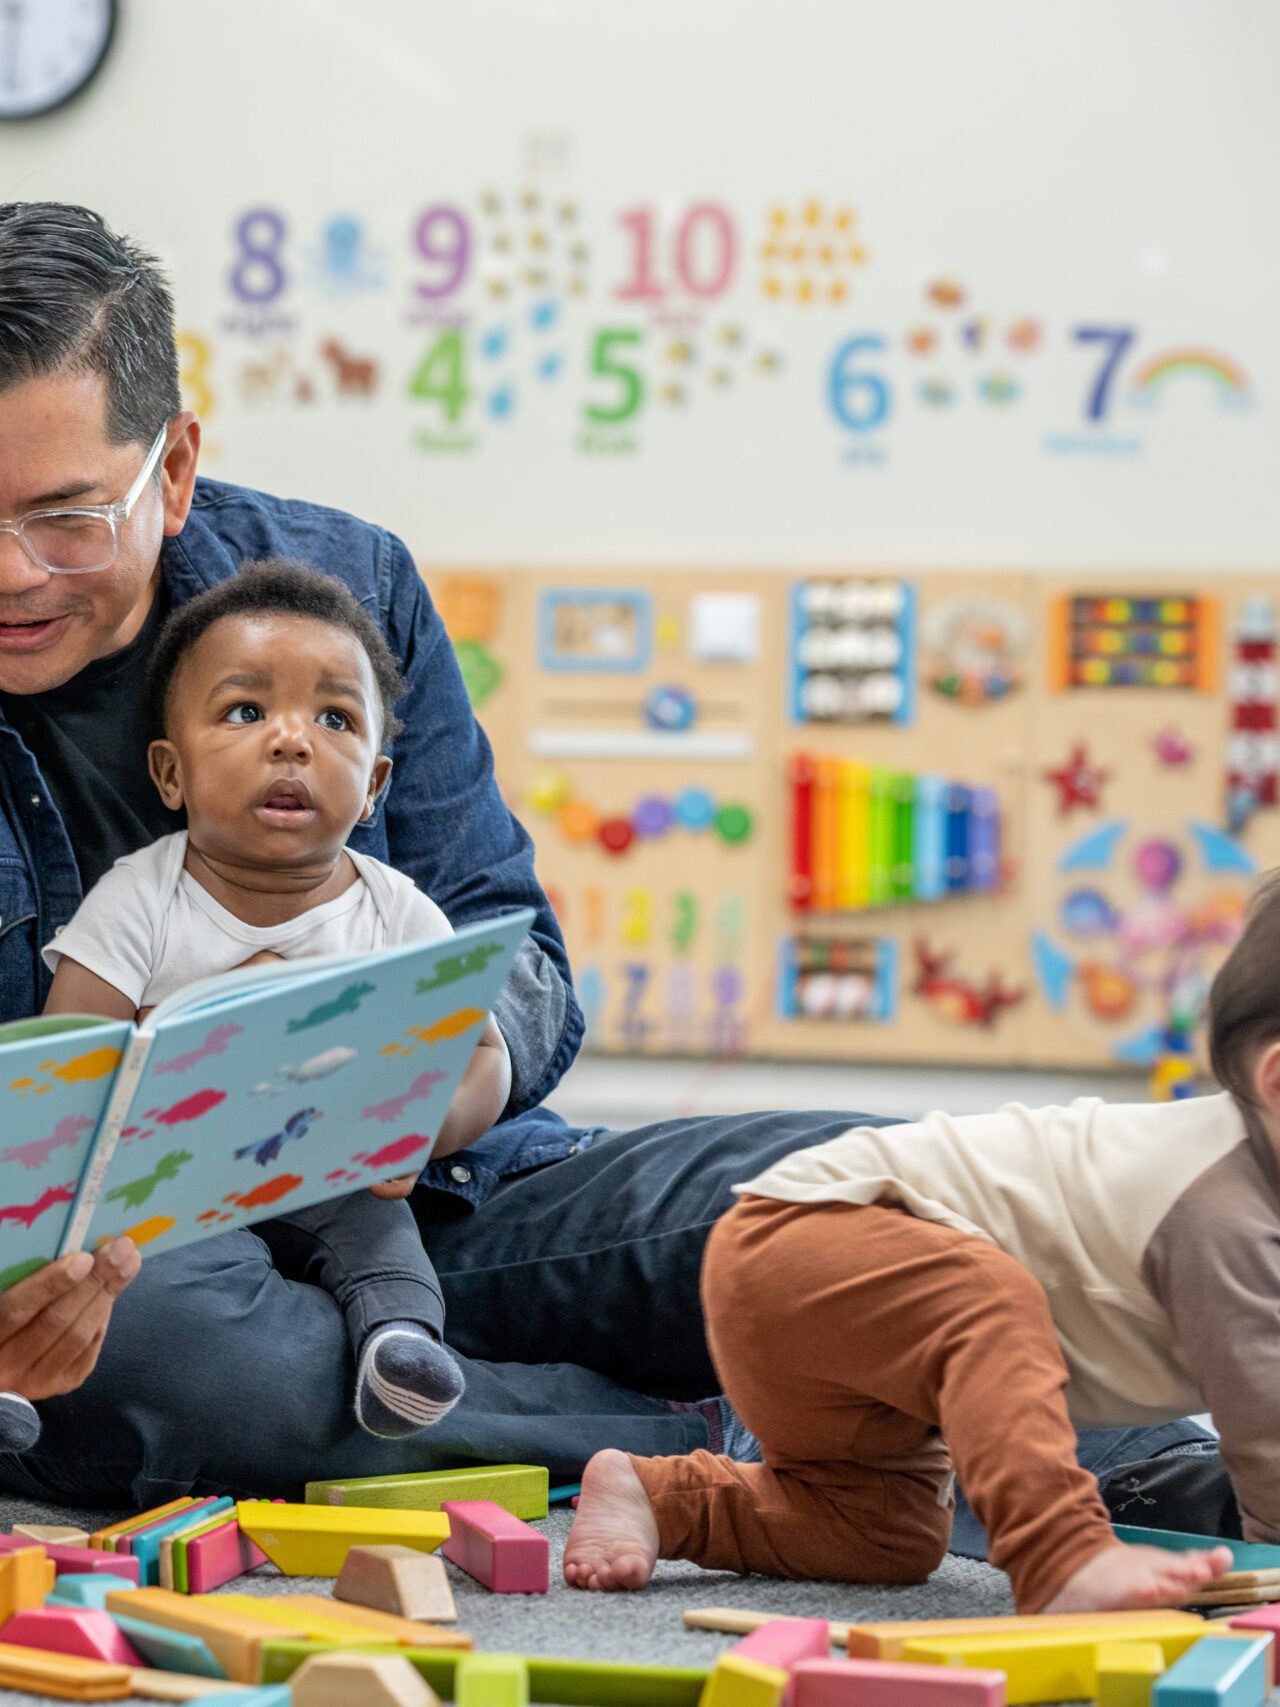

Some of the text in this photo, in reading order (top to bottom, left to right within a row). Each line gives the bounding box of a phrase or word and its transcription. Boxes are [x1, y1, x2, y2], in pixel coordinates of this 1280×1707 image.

[227, 207, 288, 304] 8
[411, 203, 472, 303] 9
[612, 201, 738, 305] 10
[408, 322, 469, 424] 4
[584, 328, 644, 425] 5
[826, 334, 891, 434] 6
[1073, 326, 1134, 423] 7
